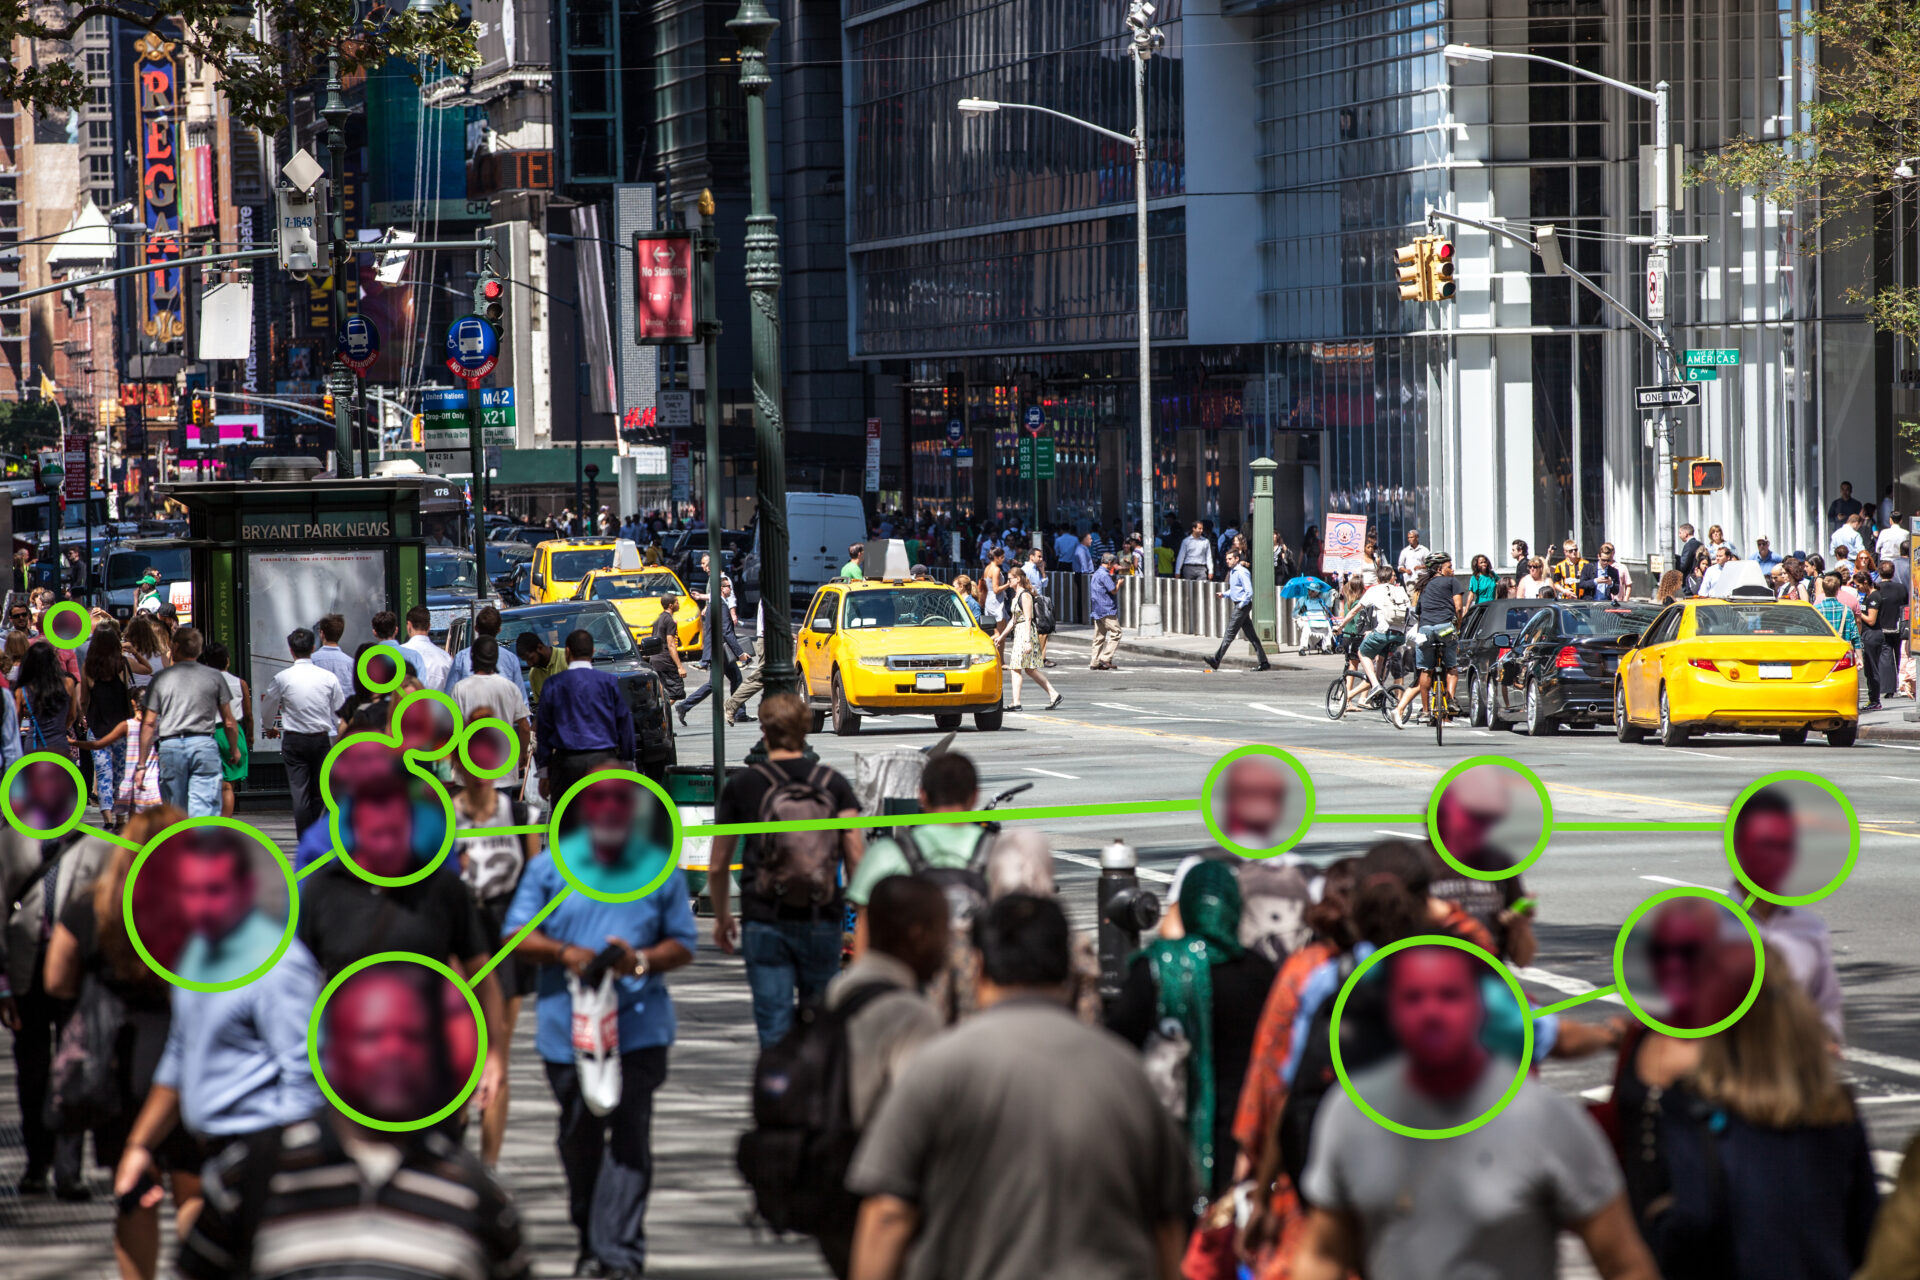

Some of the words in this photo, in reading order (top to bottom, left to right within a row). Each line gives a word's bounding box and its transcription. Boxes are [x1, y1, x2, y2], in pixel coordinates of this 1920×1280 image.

[141, 71, 179, 300] REGAL
[285, 217, 313, 228] 7-1643
[641, 267, 652, 277] No
[654, 266, 688, 278] Standing
[311, 284, 329, 328] NEW
[340, 354, 350, 365] NO
[350, 352, 377, 368] STANDING
[1687, 355, 1736, 364] AMERICAS
[451, 361, 460, 371] NO
[461, 360, 494, 378] STANDING
[1689, 367, 1698, 380] 6
[443, 392, 465, 400] Nations
[482, 390, 510, 405] M42
[1645, 393, 1664, 402] ONE
[1671, 391, 1690, 400] WAY
[425, 412, 451, 421] Drop-Off
[451, 411, 465, 420] Only
[434, 488, 450, 497] 178
[242, 524, 301, 540] BRYANT
[303, 523, 342, 538] PARK
[346, 521, 391, 537] NEWS
[220, 581, 228, 617] PARK
